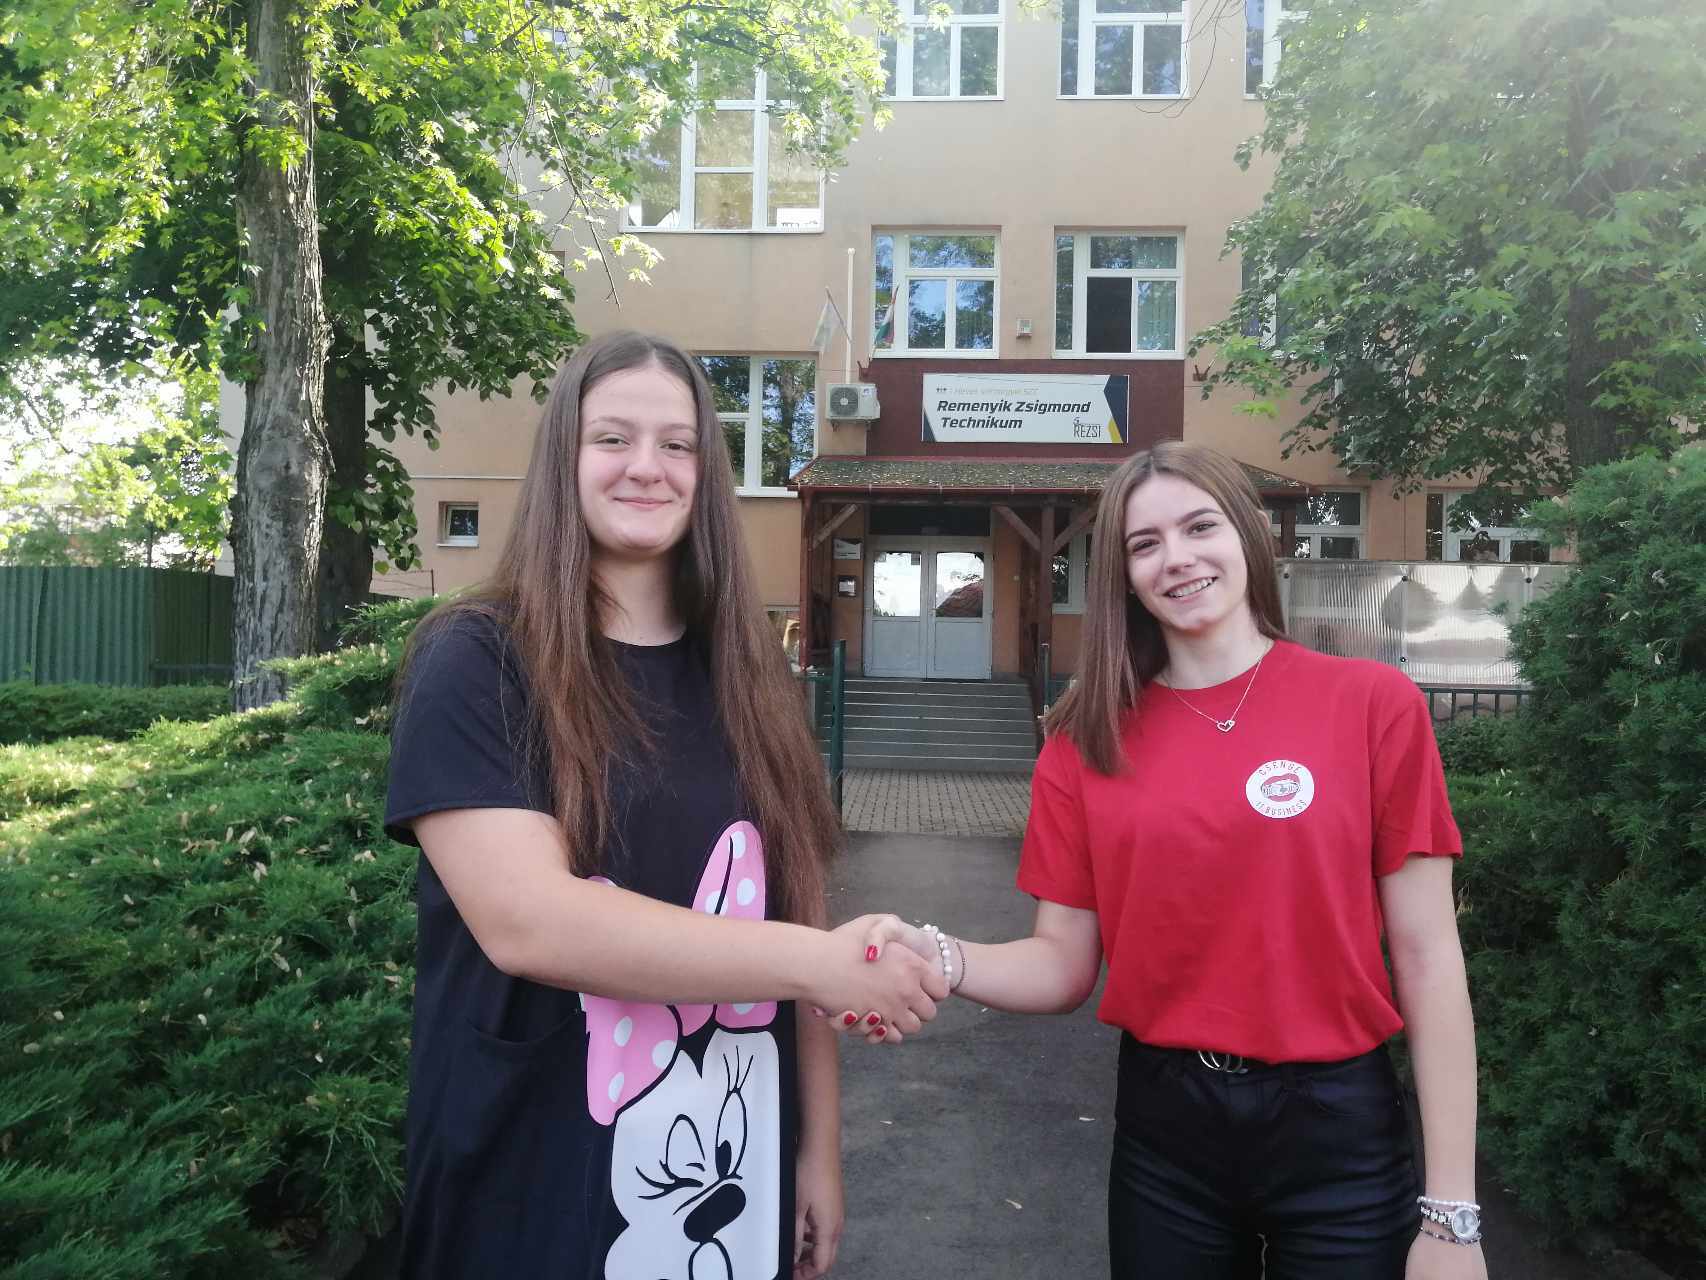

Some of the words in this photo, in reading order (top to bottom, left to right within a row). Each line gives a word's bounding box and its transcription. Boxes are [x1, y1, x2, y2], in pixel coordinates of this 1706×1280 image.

[937, 400, 1012, 414] Remenyik
[1014, 401, 1091, 415] Zsigmond
[941, 416, 1023, 429] Technikum
[1265, 799, 1307, 816] BUSINESS
